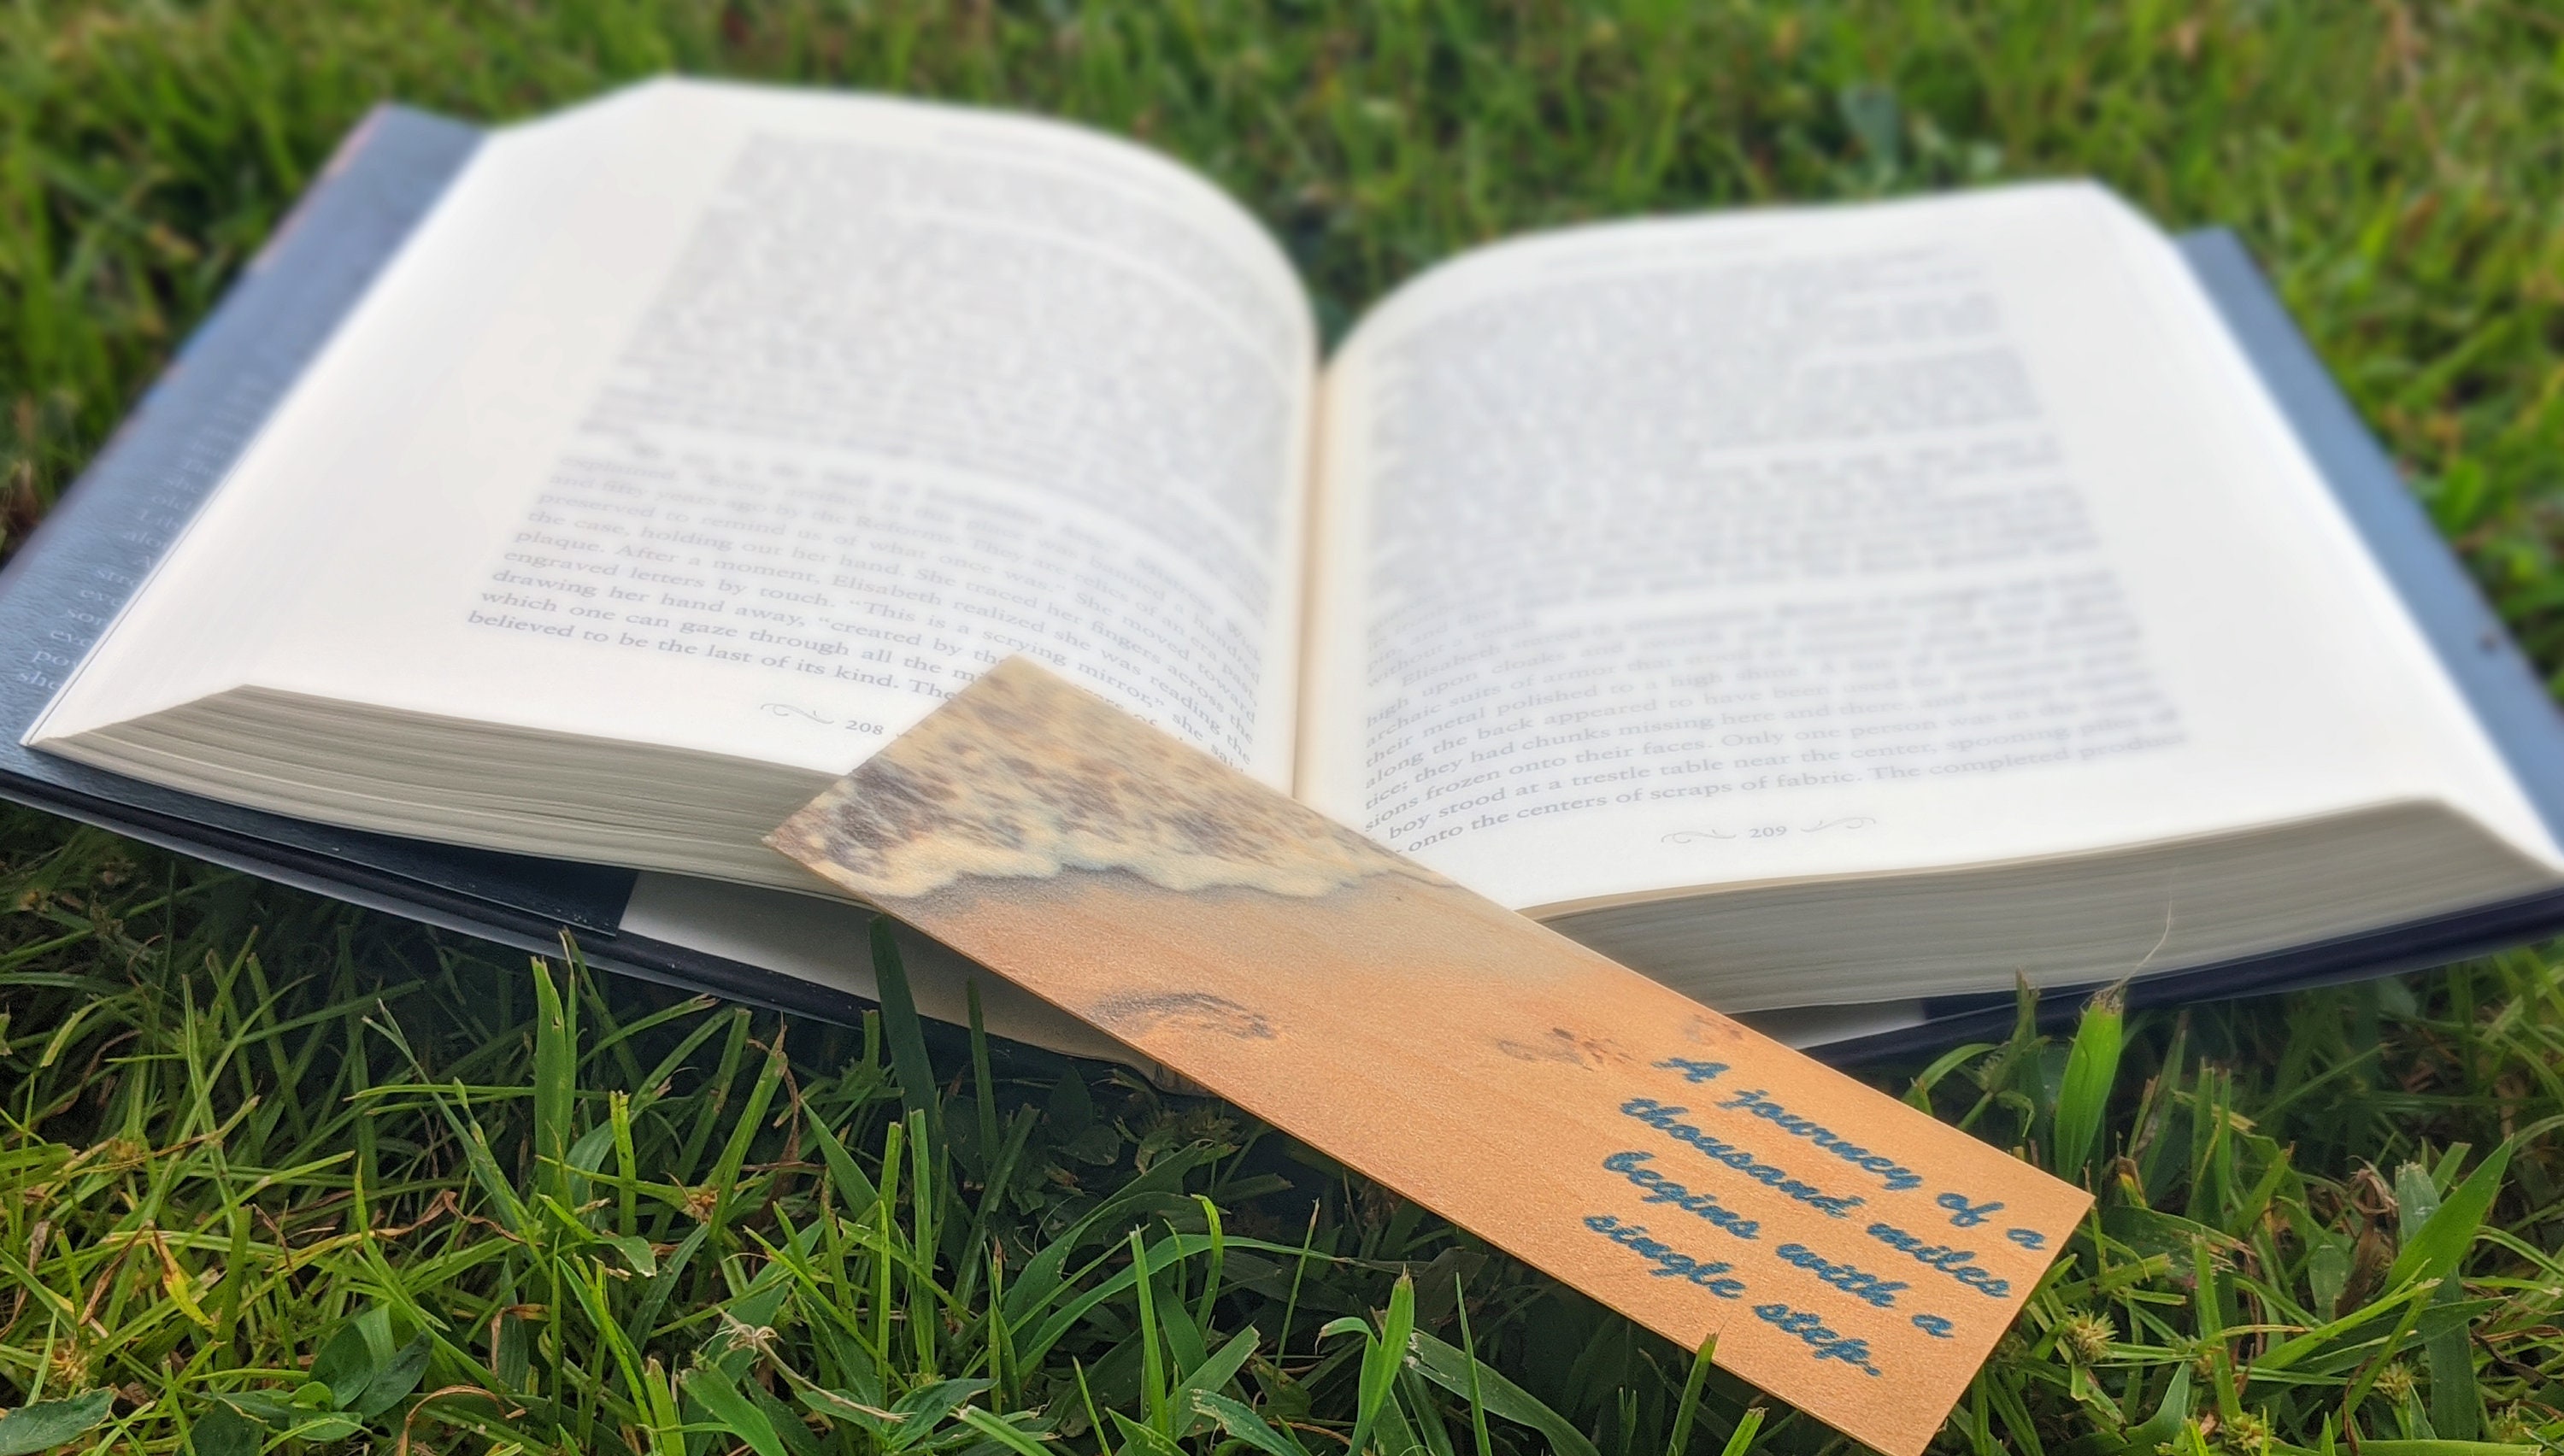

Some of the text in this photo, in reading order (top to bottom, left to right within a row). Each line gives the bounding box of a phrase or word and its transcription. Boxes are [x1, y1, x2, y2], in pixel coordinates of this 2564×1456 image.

[468, 610, 574, 637] believed
[583, 631, 609, 642] to
[619, 633, 648, 648] be
[658, 639, 697, 655] the
[706, 644, 752, 663] last
[761, 655, 790, 668] of
[797, 660, 826, 675] its
[834, 664, 898, 689] kind.
[481, 592, 941, 673] which one can gaze through all the
[492, 570, 597, 597] drawing
[609, 587, 650, 602] her
[660, 593, 724, 614] hand
[734, 607, 804, 627] away,
[933, 638, 964, 656] by
[504, 552, 620, 575] engraved
[630, 567, 705, 587] letters
[717, 580, 748, 595] by
[760, 587, 835, 608] touch.
[928, 616, 945, 629] is
[957, 625, 969, 634] a
[983, 631, 1067, 666] scrying
[1172, 713, 1203, 741] she
[513, 531, 605, 553] plaque.
[615, 545, 679, 563] After
[689, 557, 700, 566] a
[713, 560, 820, 584] moment,
[831, 575, 941, 605] Elisabeth
[952, 601, 1046, 633] realized
[1055, 631, 1091, 651] she
[1101, 649, 1141, 676] was
[1150, 675, 1221, 735] reading
[1226, 734, 1251, 766] the
[528, 512, 566, 525] the
[574, 520, 630, 536] case,
[641, 526, 733, 551] holding
[741, 542, 783, 555] out
[792, 547, 831, 562] her
[839, 555, 904, 577] hand.
[915, 569, 956, 586] She
[966, 583, 1038, 608] traced
[1047, 602, 1083, 625] her
[1091, 620, 1161, 665] fingers
[1167, 665, 1225, 713] across
[1230, 714, 1254, 744] the
[537, 494, 656, 517] preserved
[667, 513, 690, 522] to
[702, 515, 786, 536] remind
[798, 529, 821, 541] us
[834, 536, 857, 546] of
[869, 540, 926, 559] what
[938, 555, 992, 574] once
[1074, 592, 1114, 617] She
[1121, 615, 1190, 661] moved
[1197, 663, 1256, 725] toward
[775, 503, 1258, 708] by the Reforms. They are relics of an era past,
[1038, 538, 1261, 684] was banned a hundred
[1365, 653, 1566, 730] high upon cloaks
[1366, 665, 1617, 748] archaic suits of armor
[1366, 669, 1722, 768] their metal polished to a high
[1402, 645, 1502, 687] Elisabeth
[844, 719, 885, 737] 208
[1366, 684, 1829, 789] along the back appeared to have been
[1366, 705, 1831, 811] tice; they had chunks missing here and
[1366, 719, 1938, 831] sions frozen onto their faces. Only one person
[1389, 728, 2070, 839] boy stood at a trestle table near the center, spooning
[1408, 733, 2187, 853] onto the centers of scraps of fabric. The completed product
[1749, 825, 1787, 838] 209
[1620, 1098, 2009, 1297] thousand miles
[1651, 1057, 2046, 1250] A journey of a
[1583, 1215, 1881, 1377] single step.
[1602, 1151, 1954, 1338] begins with a
